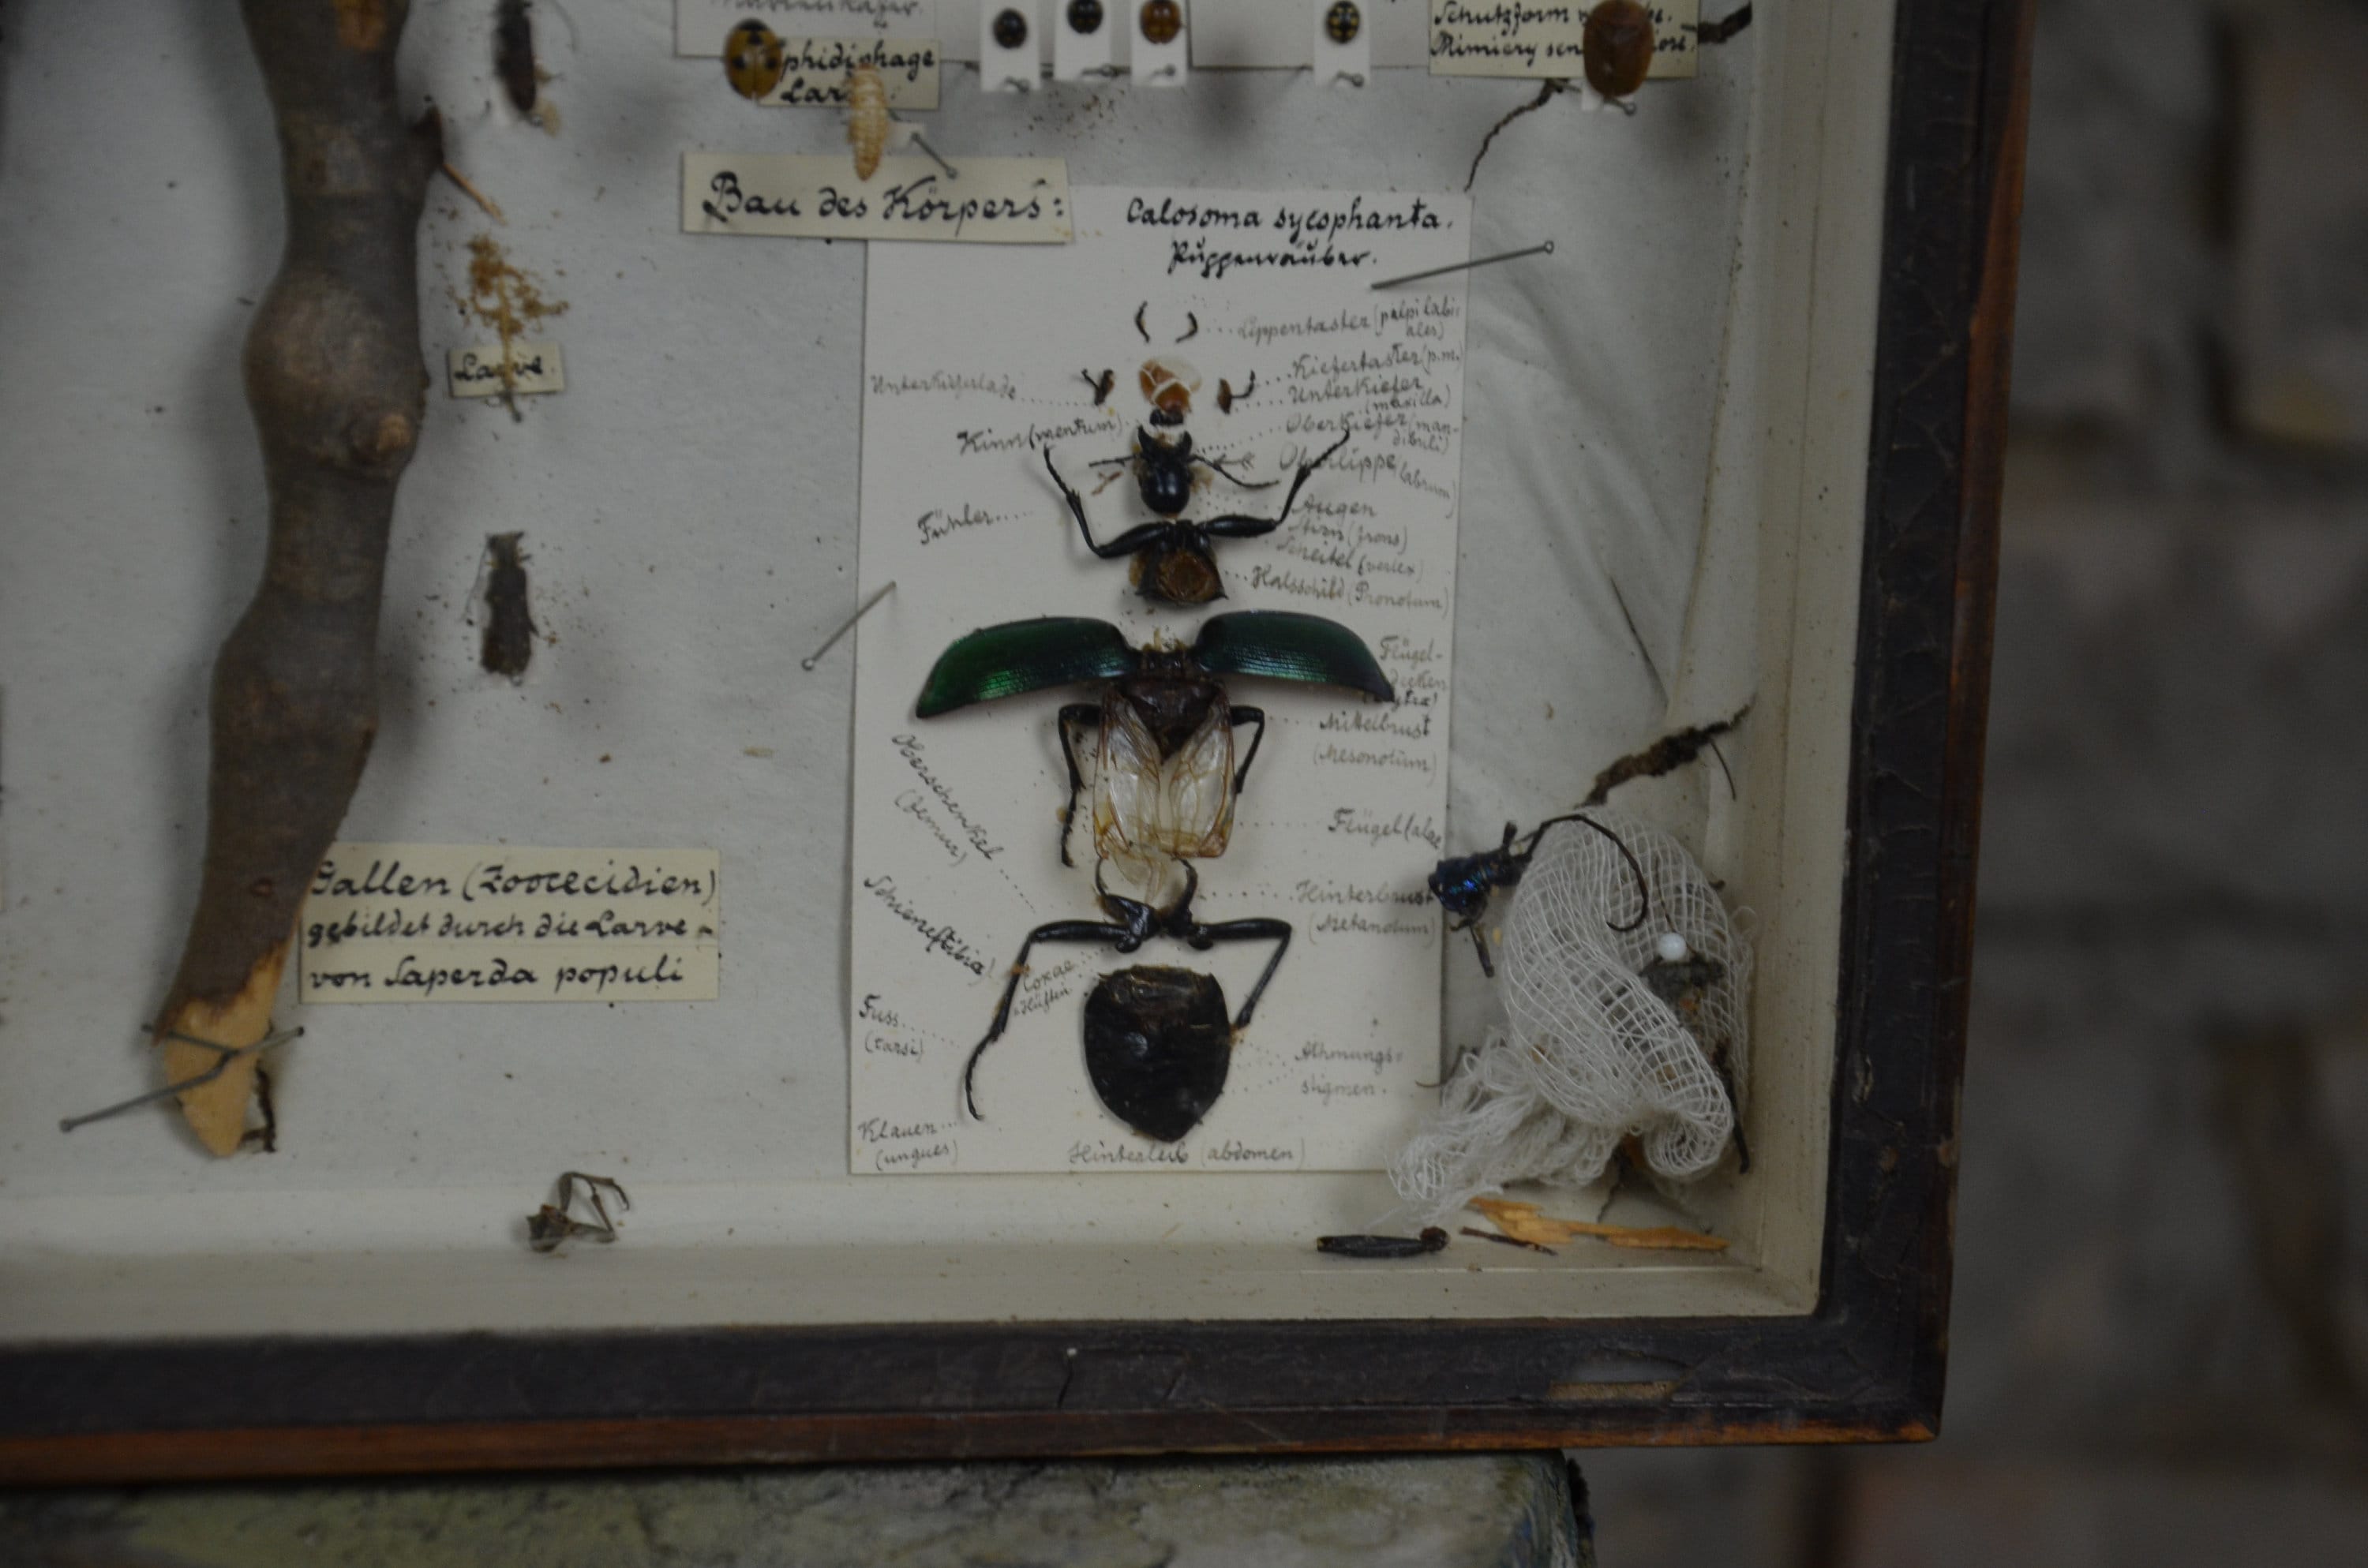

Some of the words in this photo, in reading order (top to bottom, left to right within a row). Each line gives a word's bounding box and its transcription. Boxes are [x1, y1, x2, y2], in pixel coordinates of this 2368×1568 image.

[777, 39, 936, 82] phidiphage
[702, 171, 800, 223] Bau
[819, 185, 868, 219] des
[1126, 196, 1263, 228] Calosoma
[439, 911, 526, 938] durch
[534, 911, 579, 938] die
[309, 970, 373, 990] von
[554, 952, 685, 996] populi
